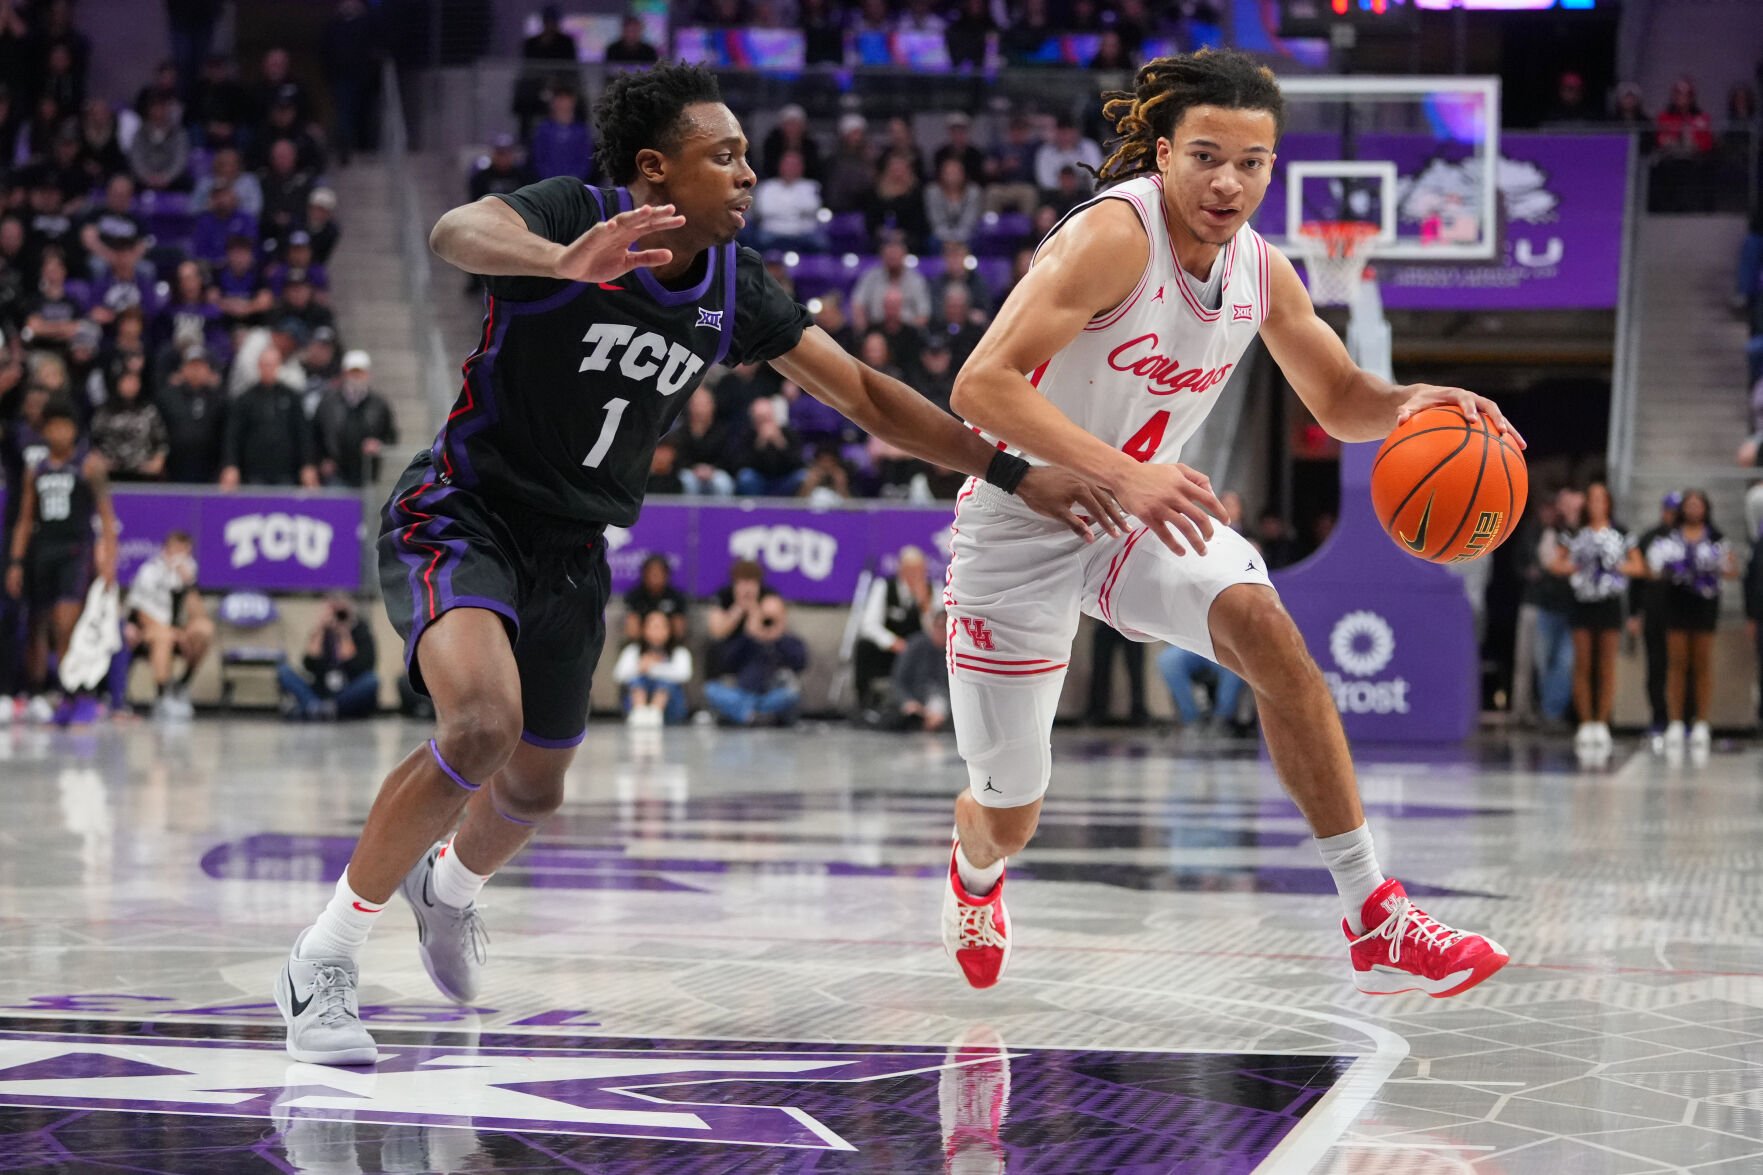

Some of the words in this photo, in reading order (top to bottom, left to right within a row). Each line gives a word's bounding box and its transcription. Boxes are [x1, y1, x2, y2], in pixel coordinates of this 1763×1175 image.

[579, 323, 705, 396] TCU
[582, 397, 631, 469] 1
[1122, 410, 1171, 464] 4
[224, 513, 333, 568] TCU
[729, 525, 838, 580] TCU
[960, 616, 996, 651] UH
